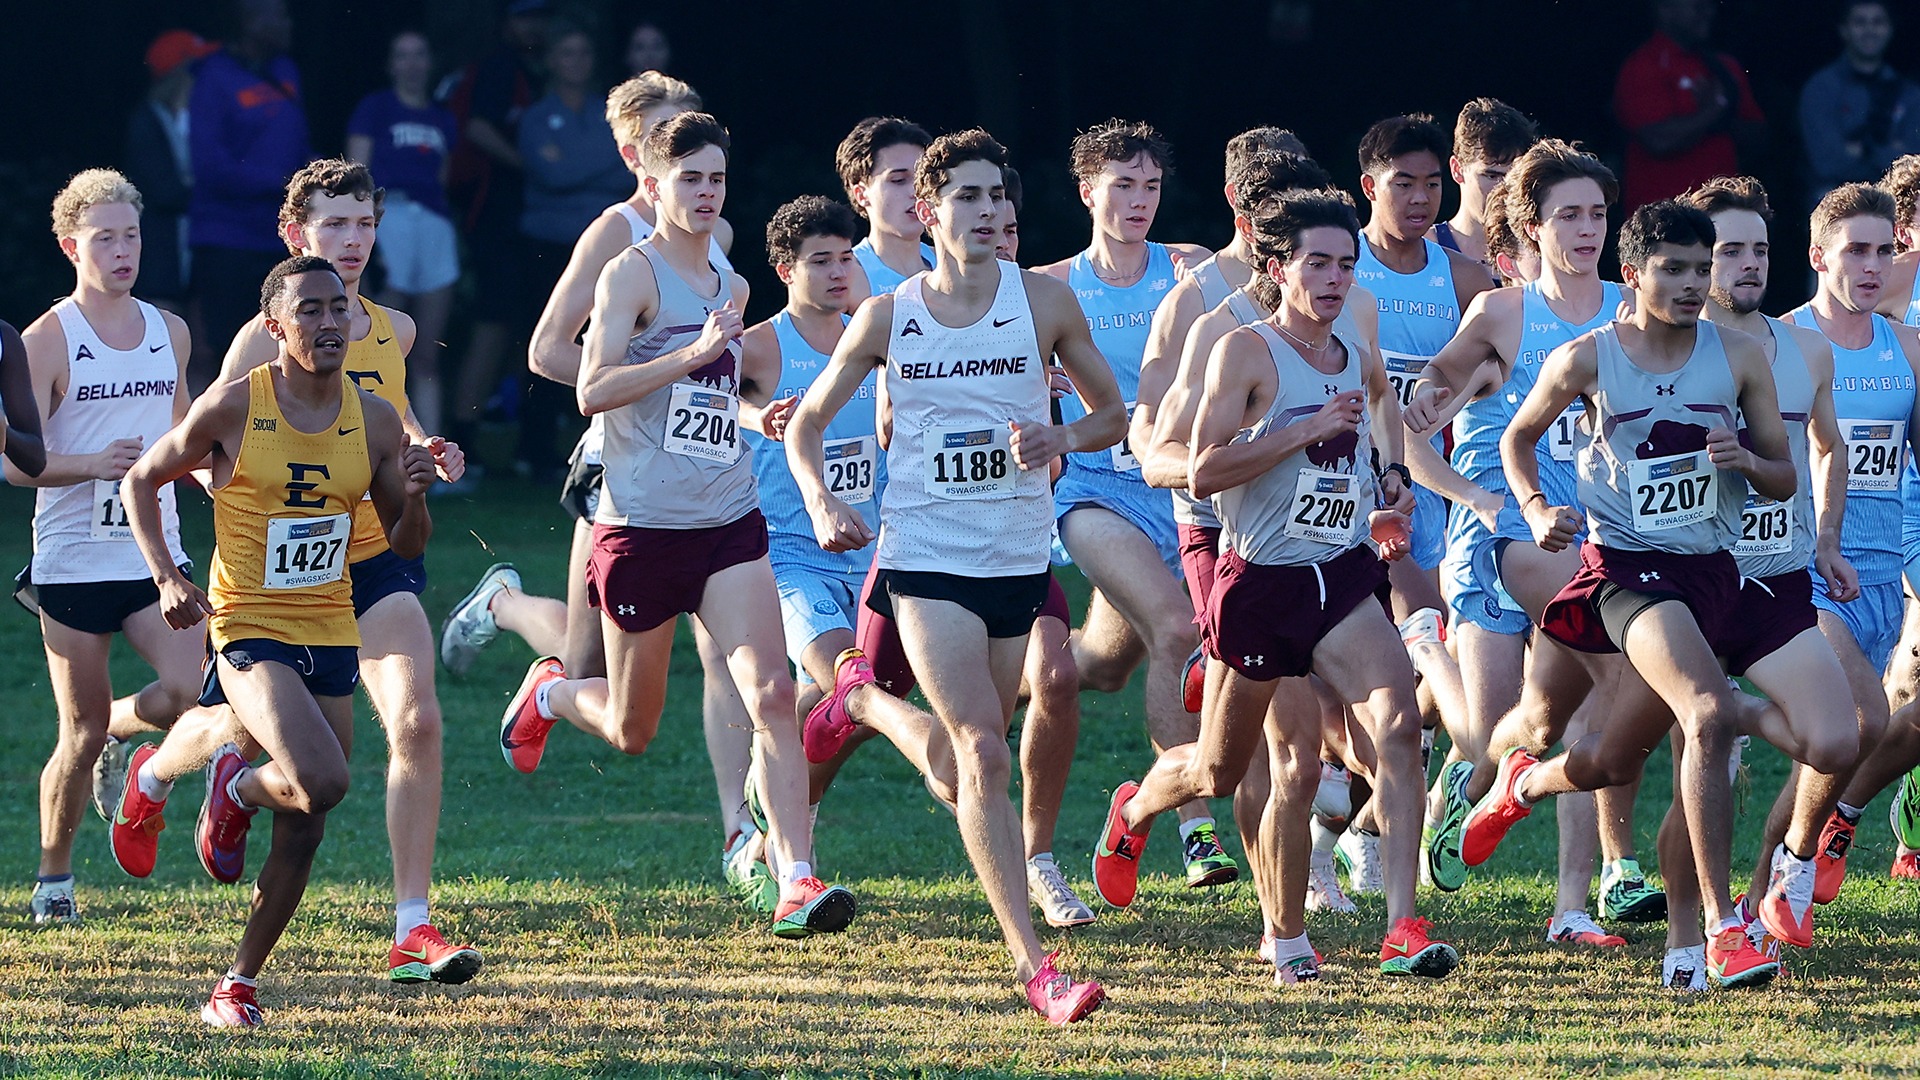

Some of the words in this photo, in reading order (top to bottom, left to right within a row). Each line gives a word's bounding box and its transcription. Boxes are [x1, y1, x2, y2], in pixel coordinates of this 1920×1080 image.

[1086, 309, 1156, 331] OLUM
[1378, 298, 1455, 321] LUMBIA
[1530, 322, 1549, 334] Ivy
[790, 359, 808, 371] Ivy
[901, 356, 1028, 380] BELLARMINE
[76, 380, 175, 402] BELLARMINE
[1389, 376, 1418, 406] 30
[1831, 375, 1914, 391] LUMBIA
[672, 408, 736, 449] 2204
[683, 444, 727, 458] #SWAGSXCC
[1846, 444, 1898, 476] 294
[829, 459, 871, 493] 293
[933, 449, 1007, 483] 1188
[1671, 464, 1694, 474] CLASSIC
[283, 462, 331, 510] E
[945, 483, 998, 494] #SWAGSXCC
[1637, 474, 1712, 516] 2207
[101, 498, 131, 527] 11
[1294, 494, 1355, 530] 2209
[1654, 511, 1704, 525] #SWAGSXCC
[1302, 529, 1345, 540] #SWAGSXCC
[1741, 507, 1788, 541] 203
[275, 538, 343, 574] 1427
[285, 572, 331, 584] #SWAGSXCC
